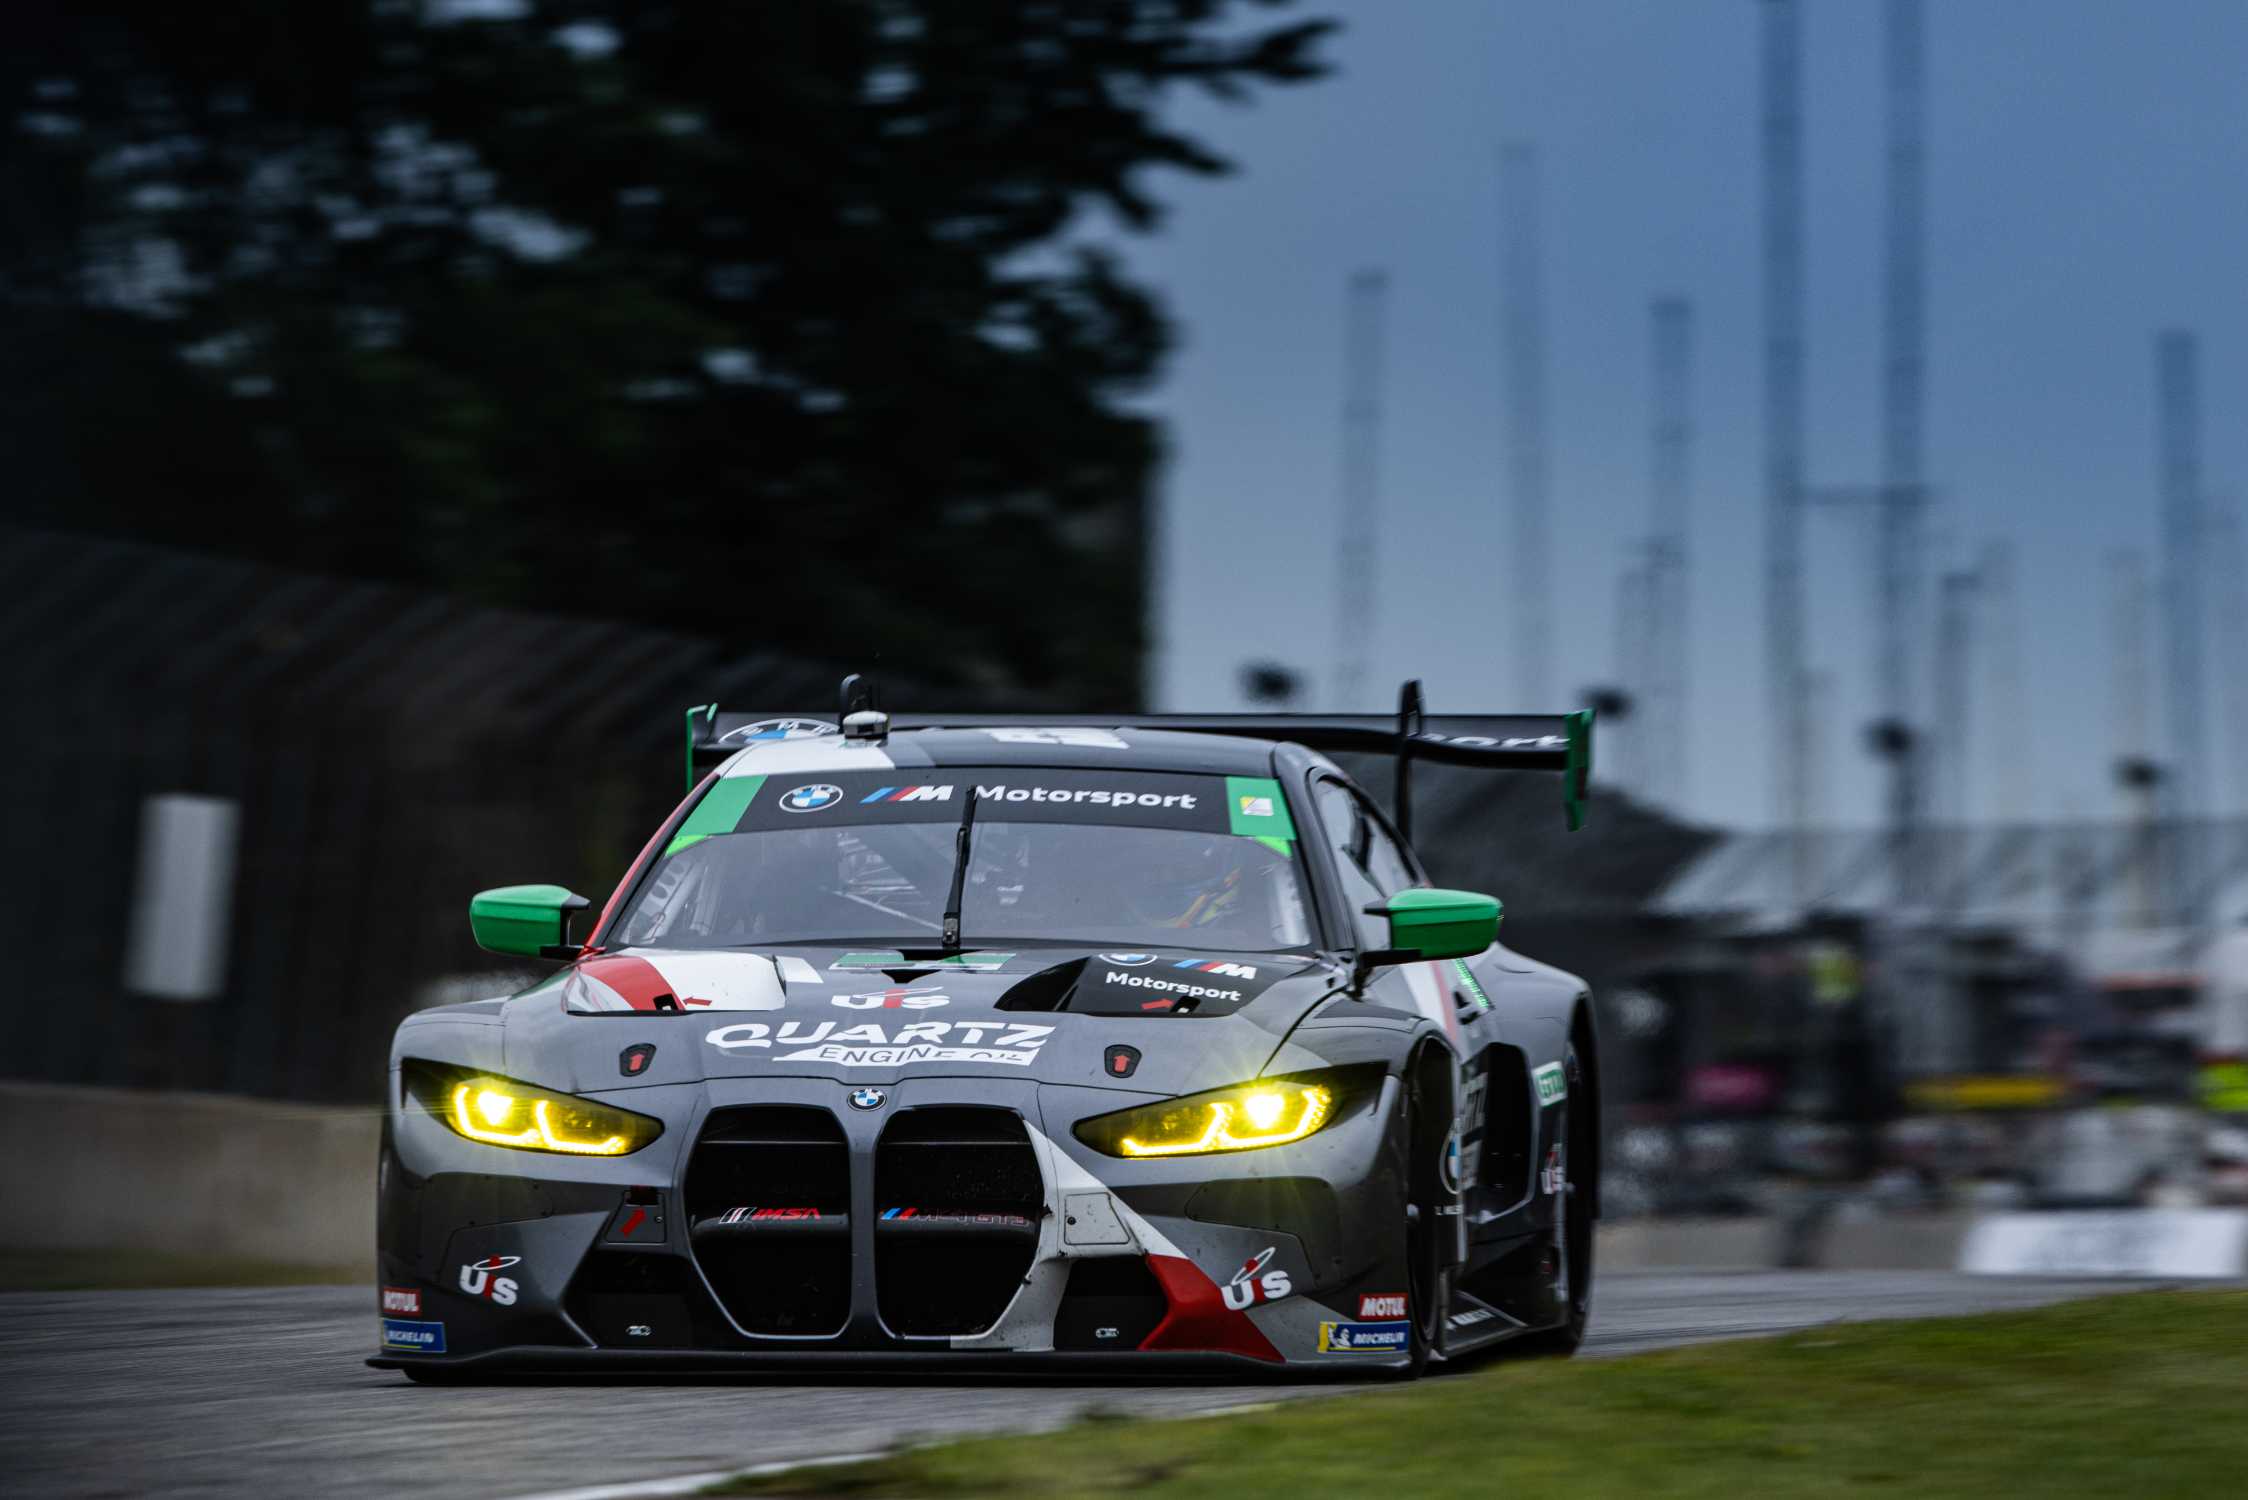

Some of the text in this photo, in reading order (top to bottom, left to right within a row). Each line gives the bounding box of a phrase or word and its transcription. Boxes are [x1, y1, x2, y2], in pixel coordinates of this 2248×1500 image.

[974, 785, 1197, 809] Motorsport
[1105, 971, 1242, 1002] Motorsport
[705, 1021, 1056, 1049] QUARTZ
[1360, 1296, 1406, 1317] MOTUL
